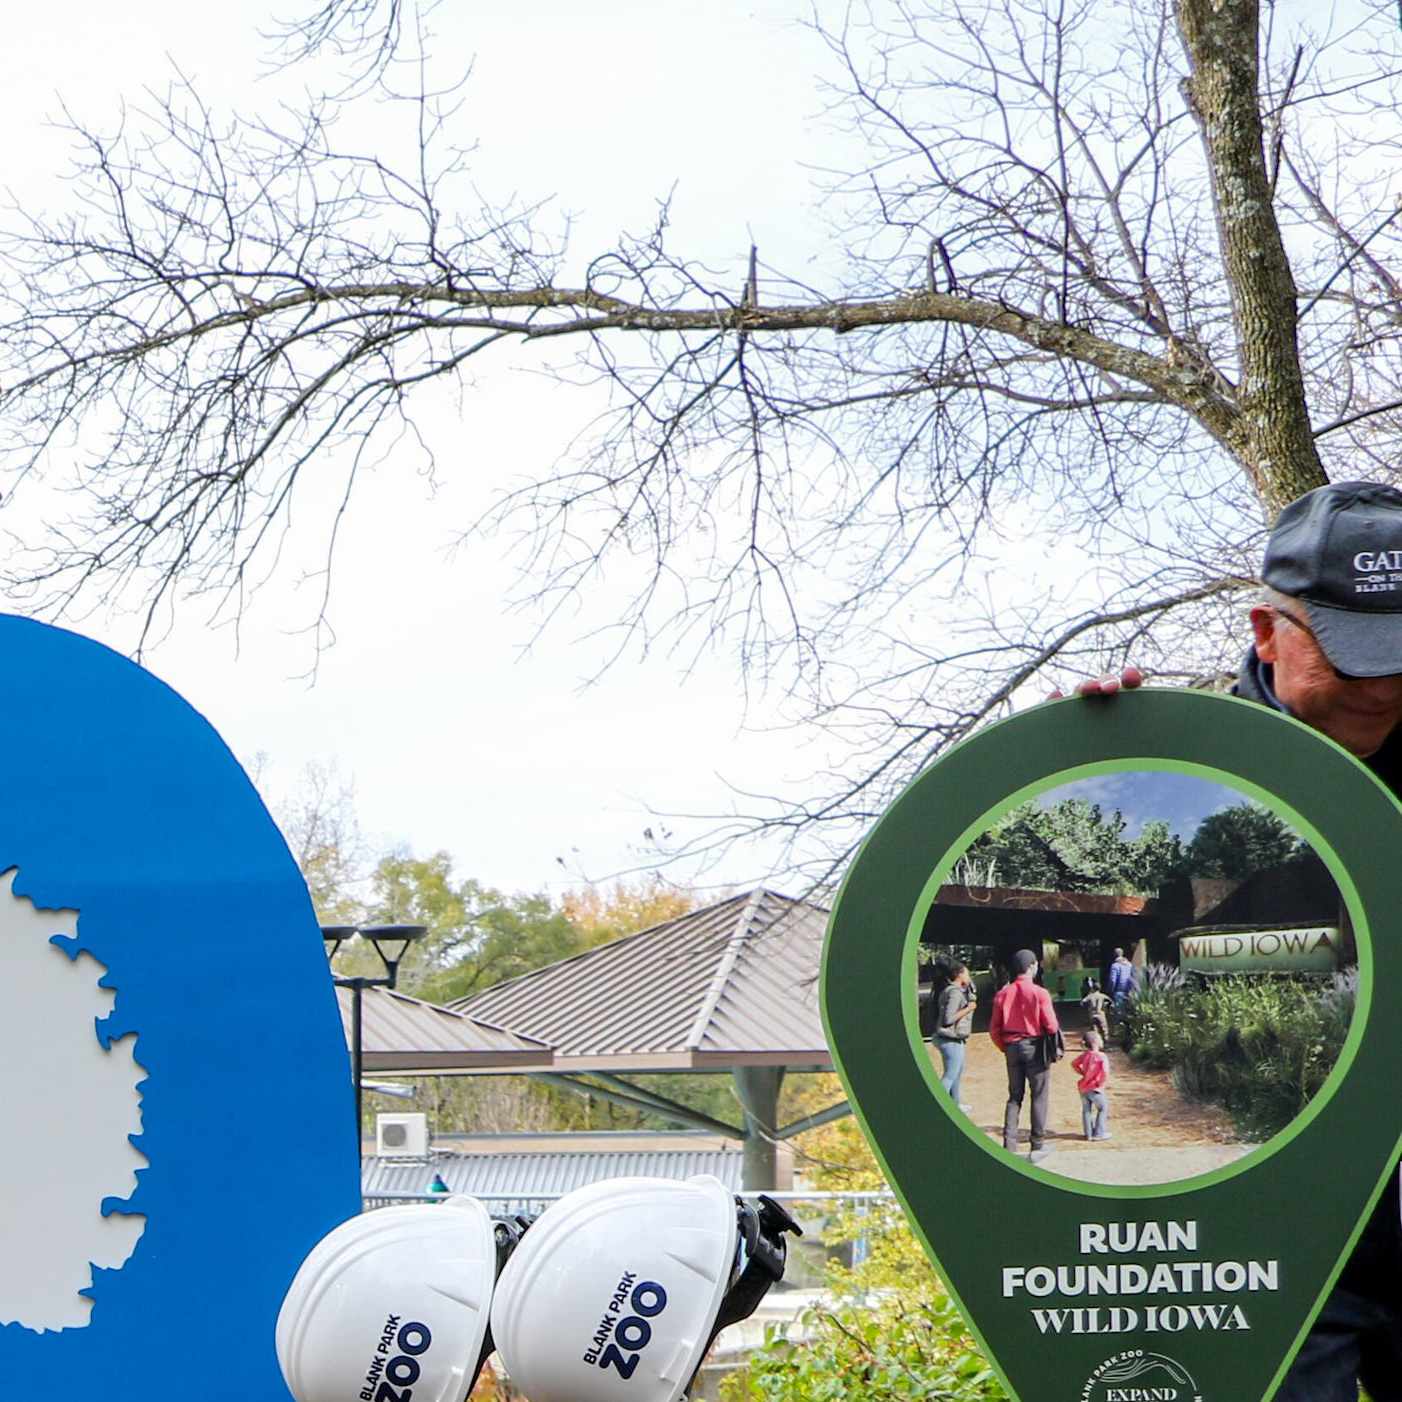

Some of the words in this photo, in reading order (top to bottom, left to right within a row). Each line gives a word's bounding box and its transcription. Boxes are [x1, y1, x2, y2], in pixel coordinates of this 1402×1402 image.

[1355, 583, 1396, 593] BLANK
[1368, 574, 1386, 583] ON
[1180, 937, 1243, 959] WILD
[1251, 931, 1335, 956] IOWA
[1080, 1220, 1197, 1254] RUAN
[1002, 1260, 1279, 1297] FOUNDATION
[582, 1314, 617, 1366] BLANK
[608, 1270, 637, 1314] PARK
[598, 1281, 668, 1380] ZOO
[1031, 1307, 1139, 1334] WILD
[1144, 1304, 1251, 1332] IOWA
[359, 1355, 386, 1402] BLANK
[377, 1314, 401, 1354] PARK
[1093, 1356, 1118, 1377] PARK
[1120, 1349, 1143, 1360] ZOO
[1106, 1388, 1178, 1402] EXPAND
